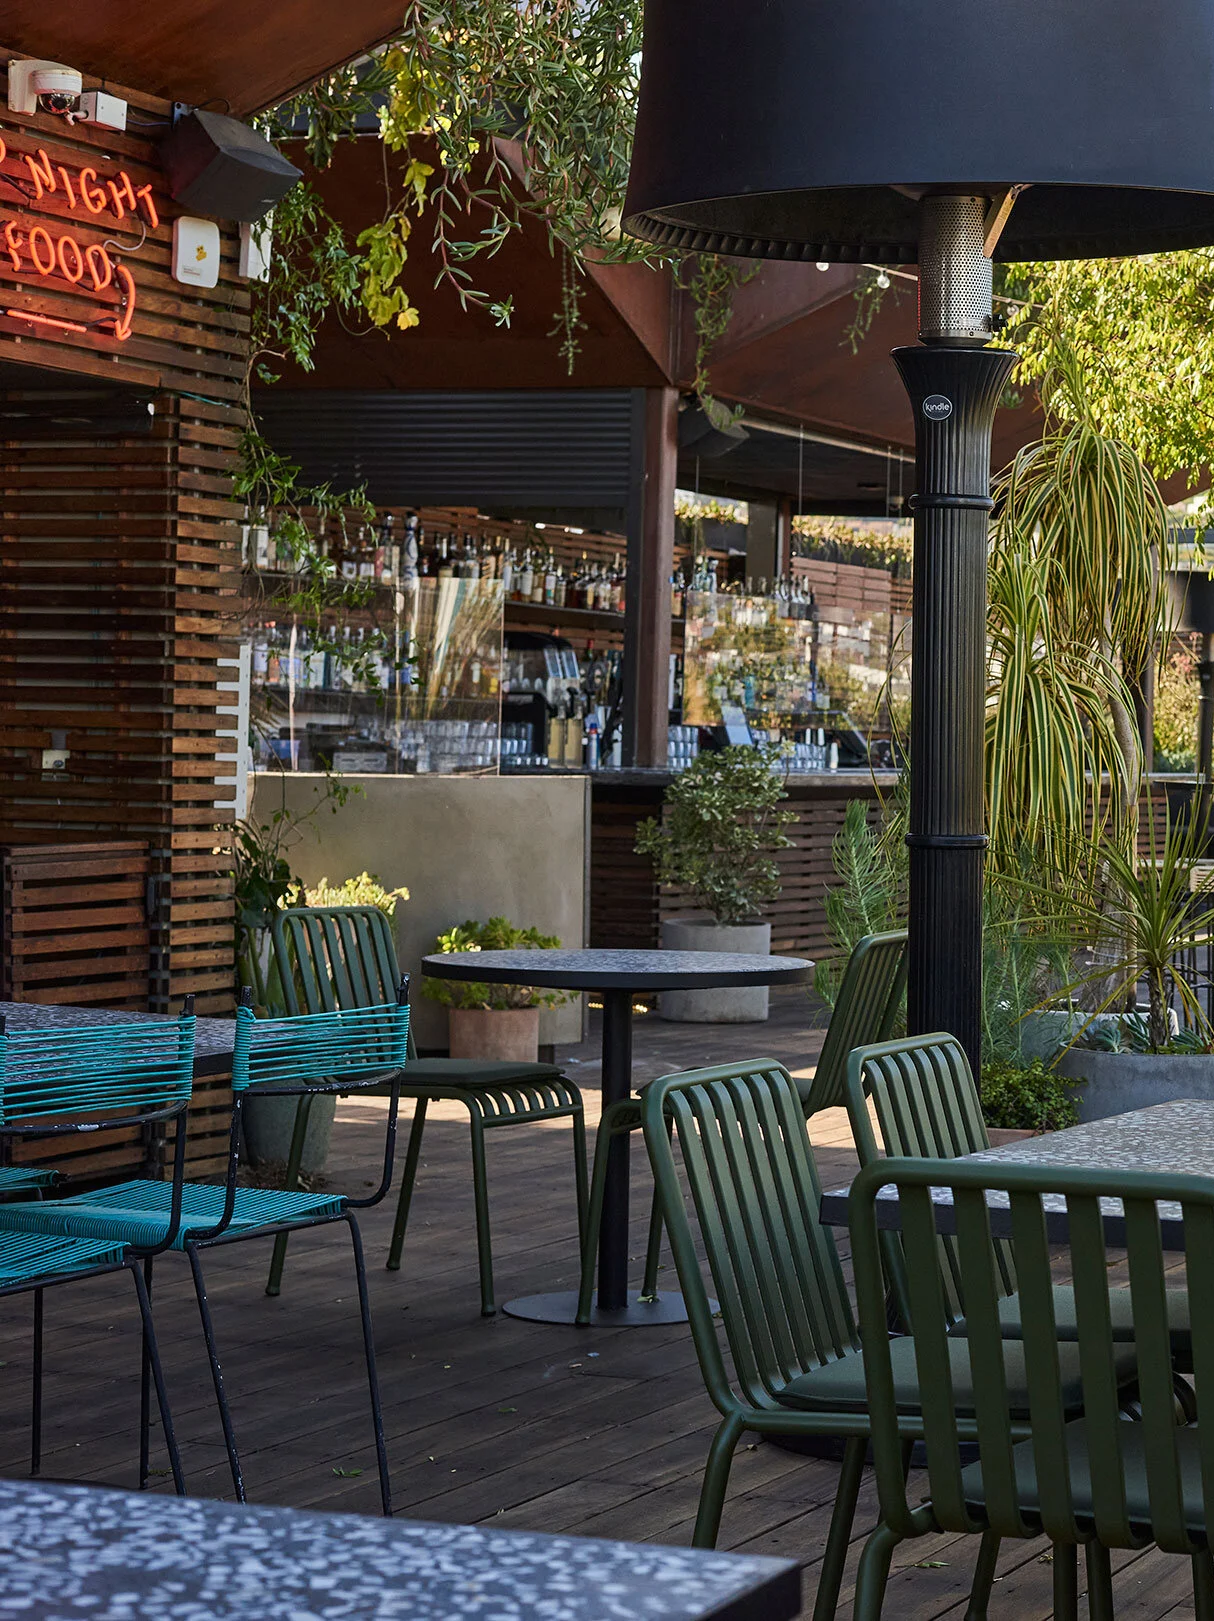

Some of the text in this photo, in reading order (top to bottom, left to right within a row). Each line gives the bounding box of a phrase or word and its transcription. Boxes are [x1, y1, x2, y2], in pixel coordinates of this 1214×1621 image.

[24, 149, 158, 228] NIGHT
[4, 220, 112, 292] FOOD
[925, 402, 950, 412] kindle
